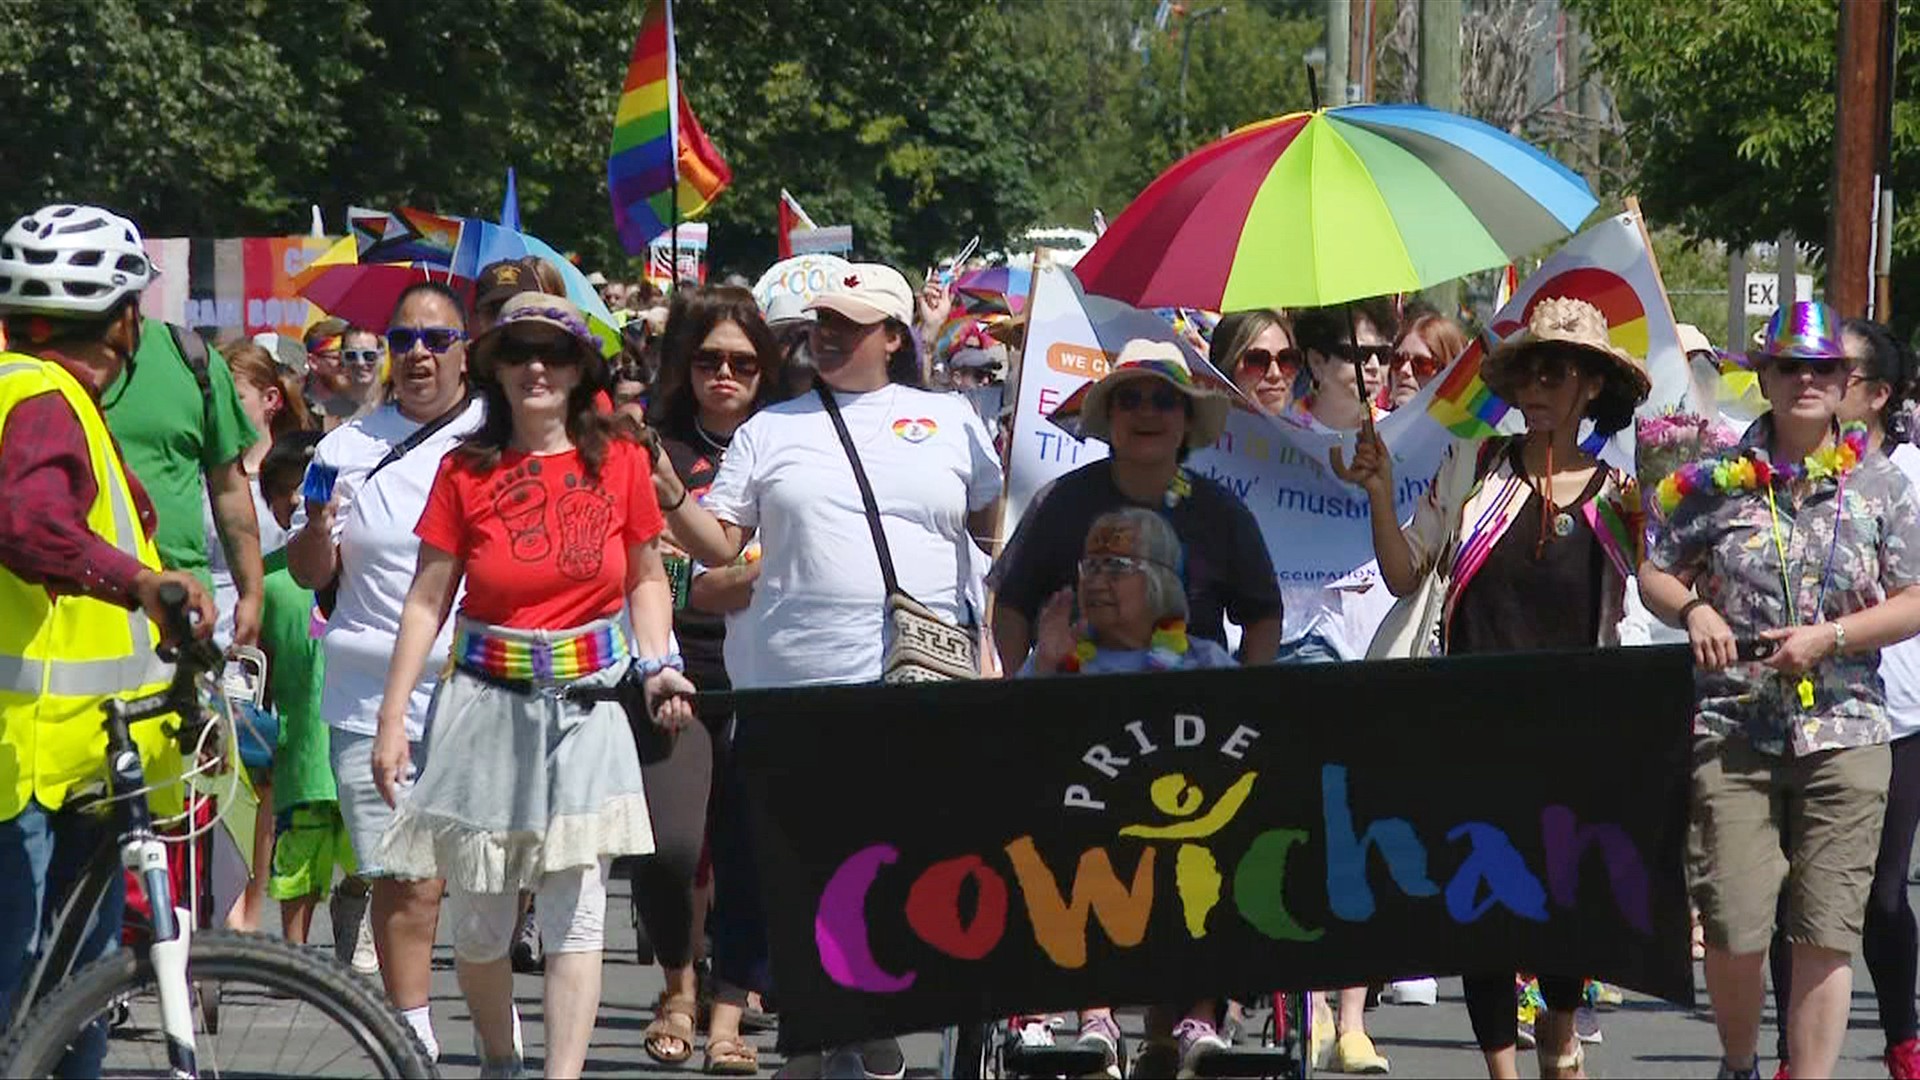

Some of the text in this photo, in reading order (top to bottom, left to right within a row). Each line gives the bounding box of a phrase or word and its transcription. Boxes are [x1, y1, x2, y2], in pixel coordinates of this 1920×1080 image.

[1748, 284, 1774, 304] EX
[1060, 352, 1087, 369] WE
[1064, 714, 1260, 811] PRIDE
